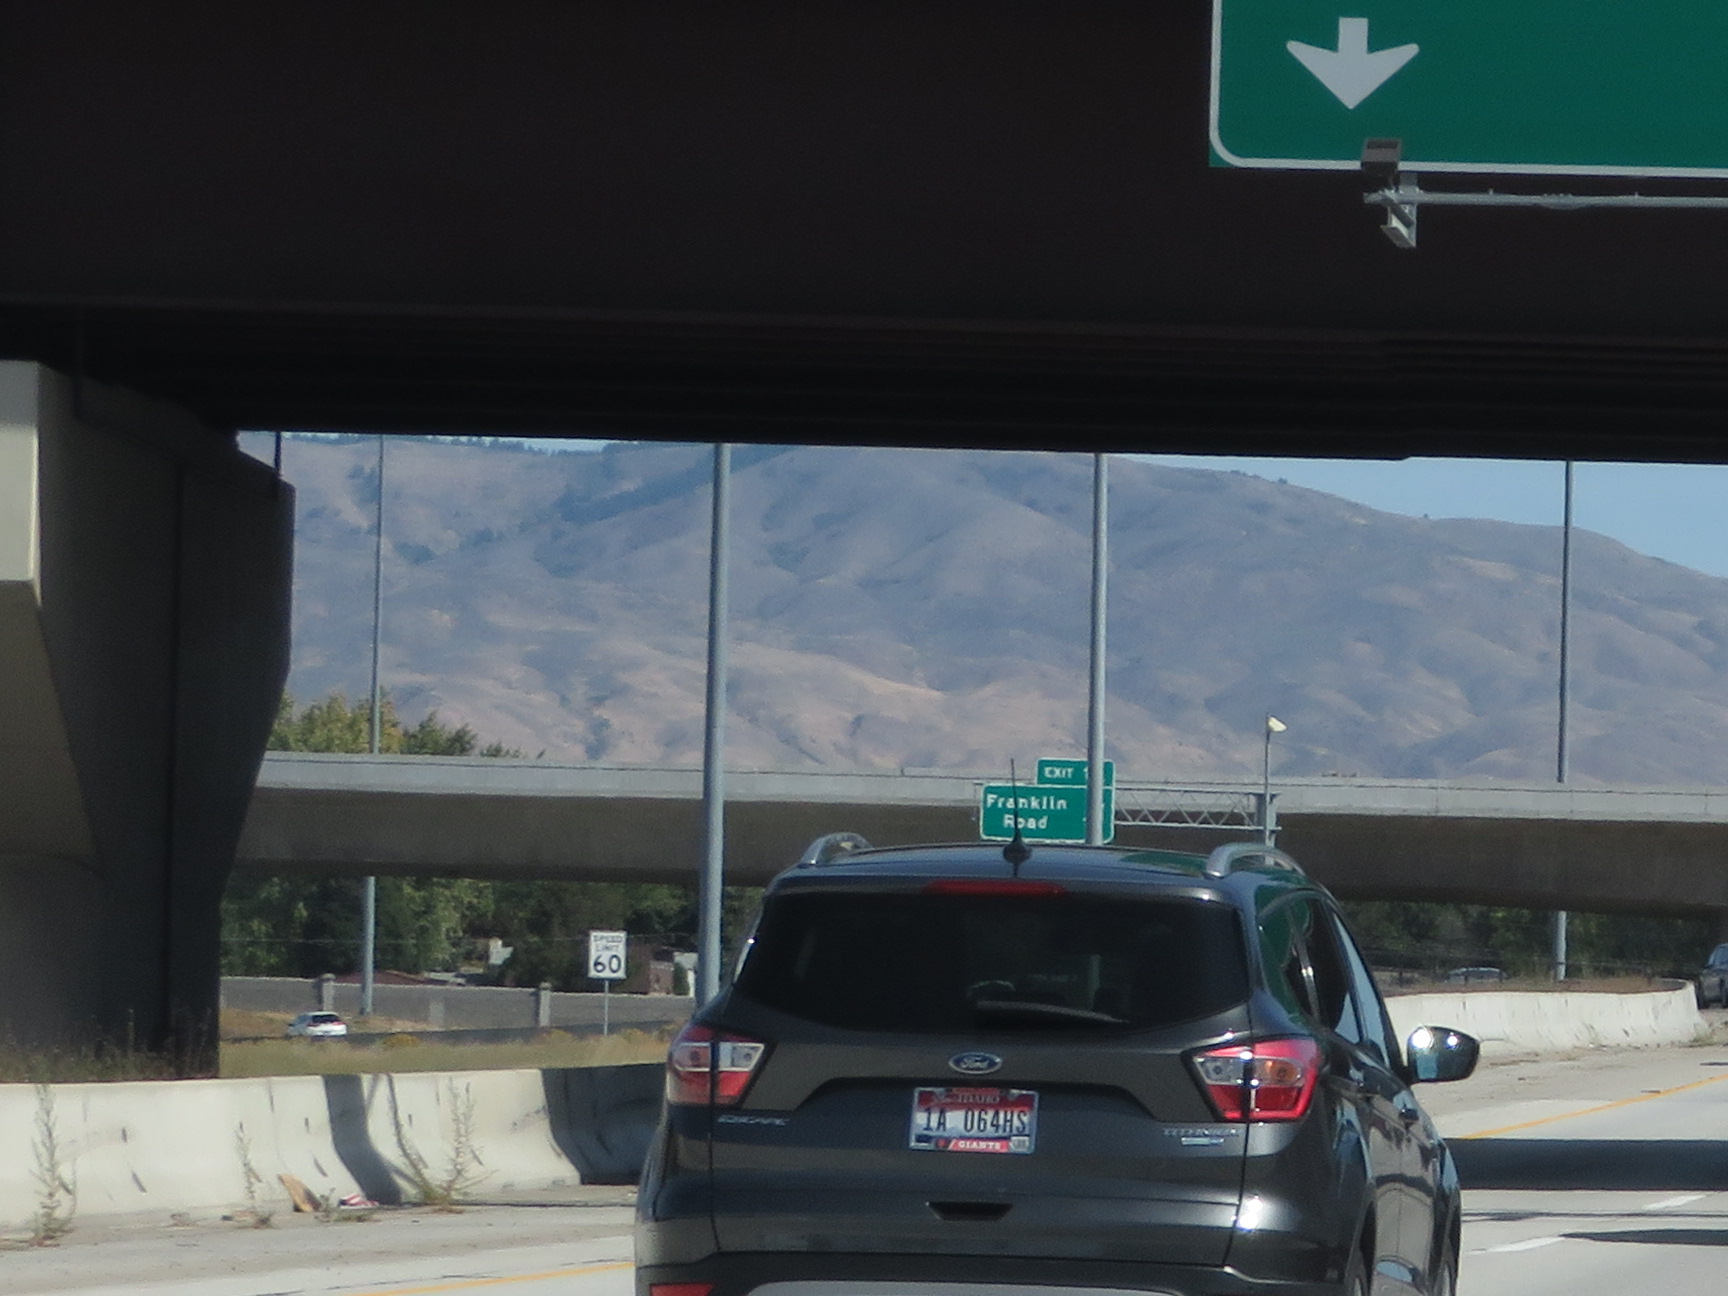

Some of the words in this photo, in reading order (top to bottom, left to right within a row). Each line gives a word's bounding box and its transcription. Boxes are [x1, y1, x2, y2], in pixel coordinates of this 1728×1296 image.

[1044, 766, 1074, 778] EXIT
[986, 793, 1067, 809] Franklin
[593, 954, 622, 973] 60
[923, 1107, 947, 1132] 1A
